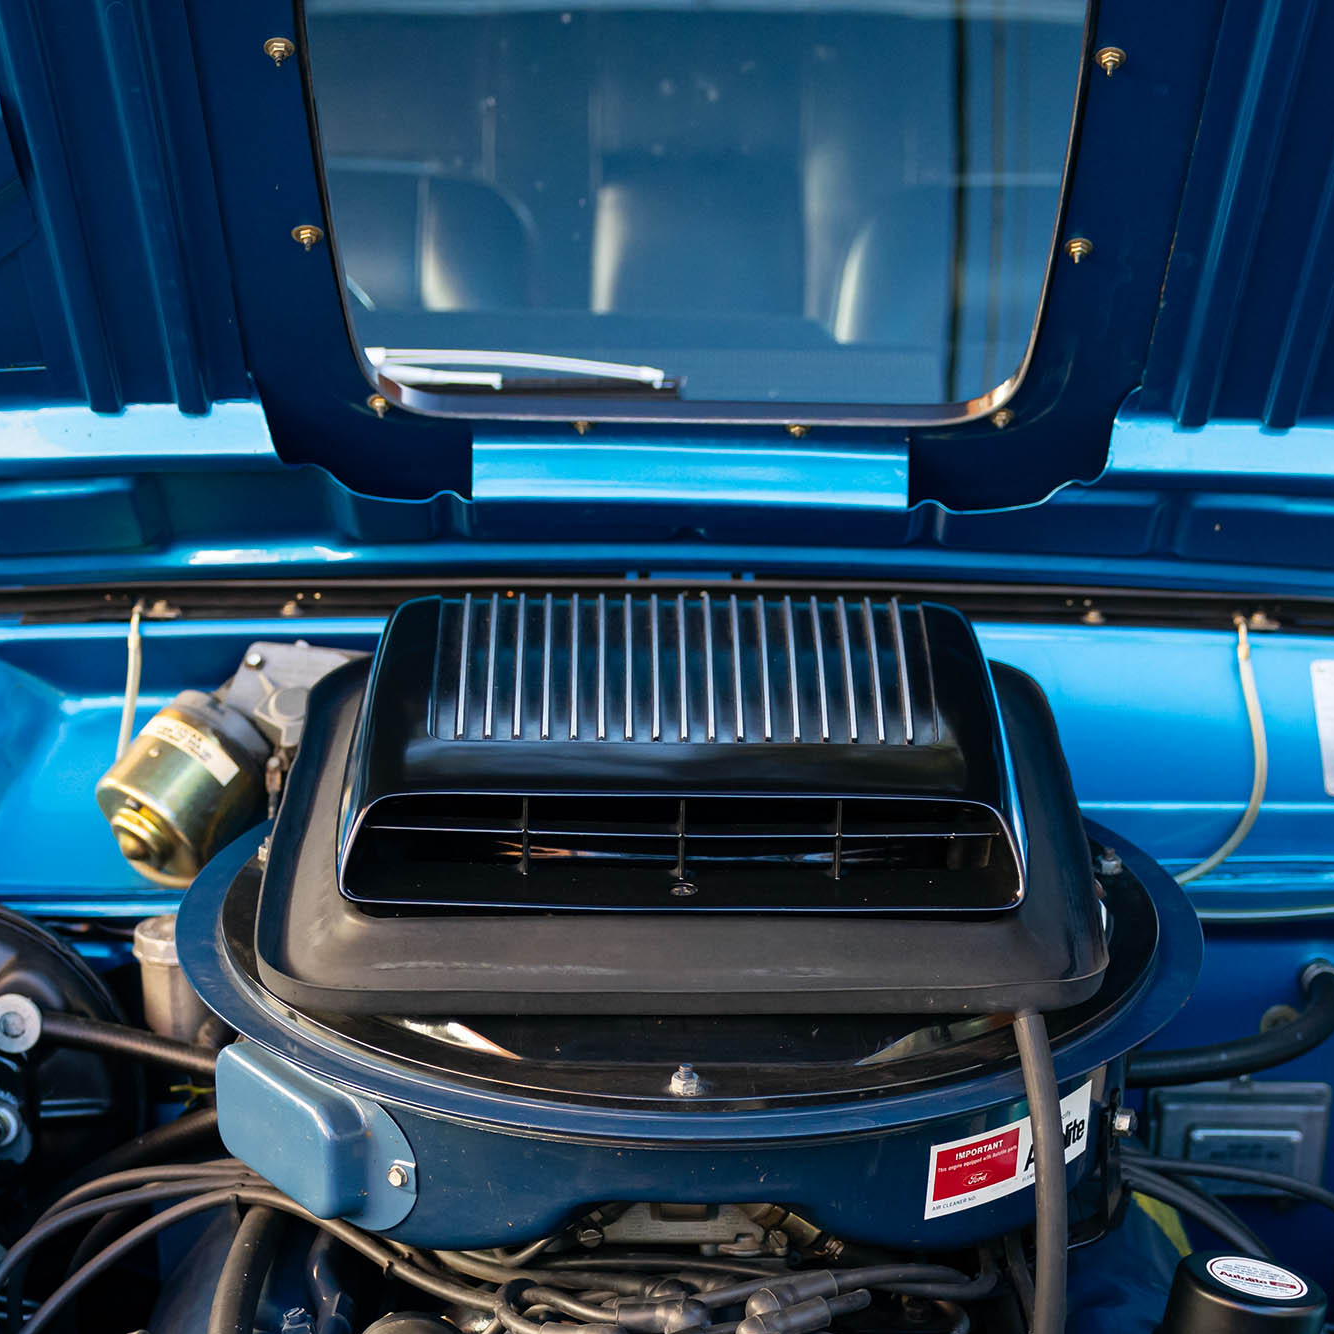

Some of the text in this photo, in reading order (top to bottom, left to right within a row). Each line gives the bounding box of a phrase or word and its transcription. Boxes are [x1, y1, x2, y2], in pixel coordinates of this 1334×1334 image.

[955, 1139, 1003, 1160] IMPORTANT
[967, 1171, 988, 1185] Ford
[932, 1203, 942, 1211] AIR
[942, 1197, 967, 1209] CLEANER
